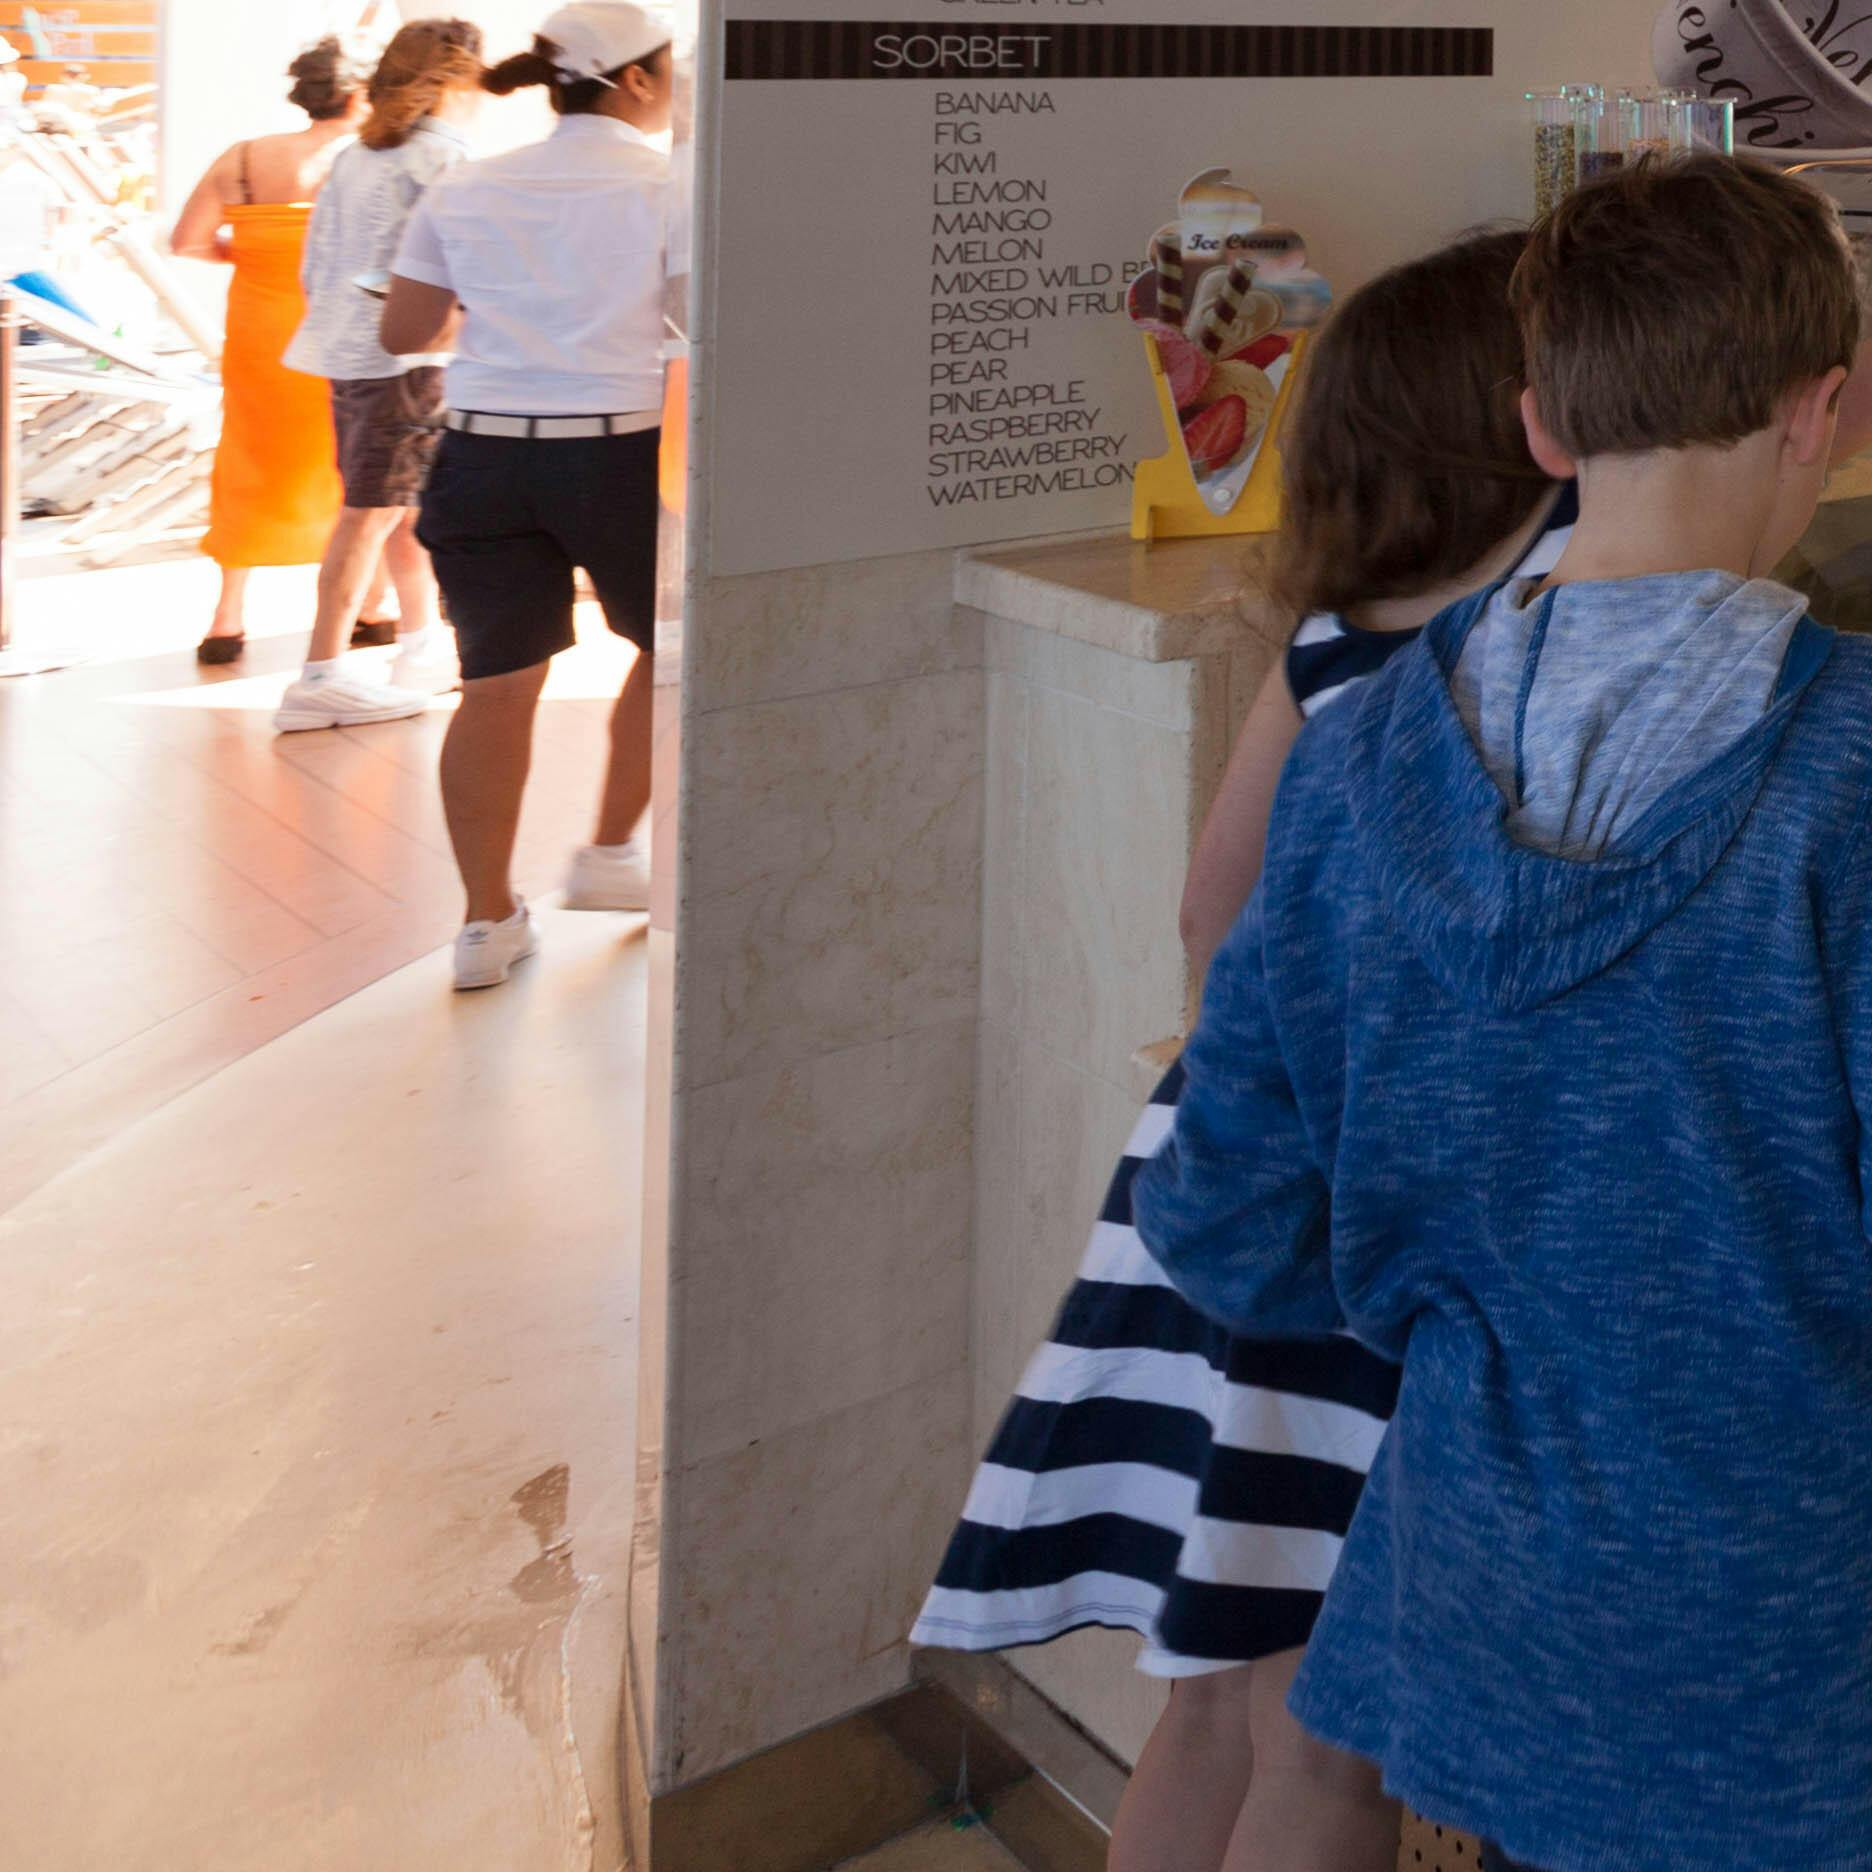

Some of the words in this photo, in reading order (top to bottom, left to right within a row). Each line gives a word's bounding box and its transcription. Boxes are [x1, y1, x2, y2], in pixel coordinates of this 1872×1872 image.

[872, 34, 1053, 70] SORBET
[934, 90, 1056, 115] BANANA
[934, 121, 982, 145] FIG
[934, 150, 996, 176] KIWI
[933, 178, 1047, 205] LEMON
[931, 208, 1053, 235] MANGO
[931, 237, 1044, 266] MELON
[1187, 233, 1221, 251] Ice
[1226, 233, 1289, 251] Cream
[931, 266, 1028, 295] MIXED
[1037, 262, 1113, 288] WILD
[931, 294, 1057, 325] PASSION
[1067, 290, 1128, 316] FRUI
[931, 327, 1029, 355] PEACH
[930, 358, 1008, 386] PEAR
[929, 380, 1086, 416] PINEAPPLE
[928, 407, 1101, 446] RASPBERRY
[927, 433, 1128, 477] STRAWBERRY
[927, 461, 1137, 507] WATERMELON
